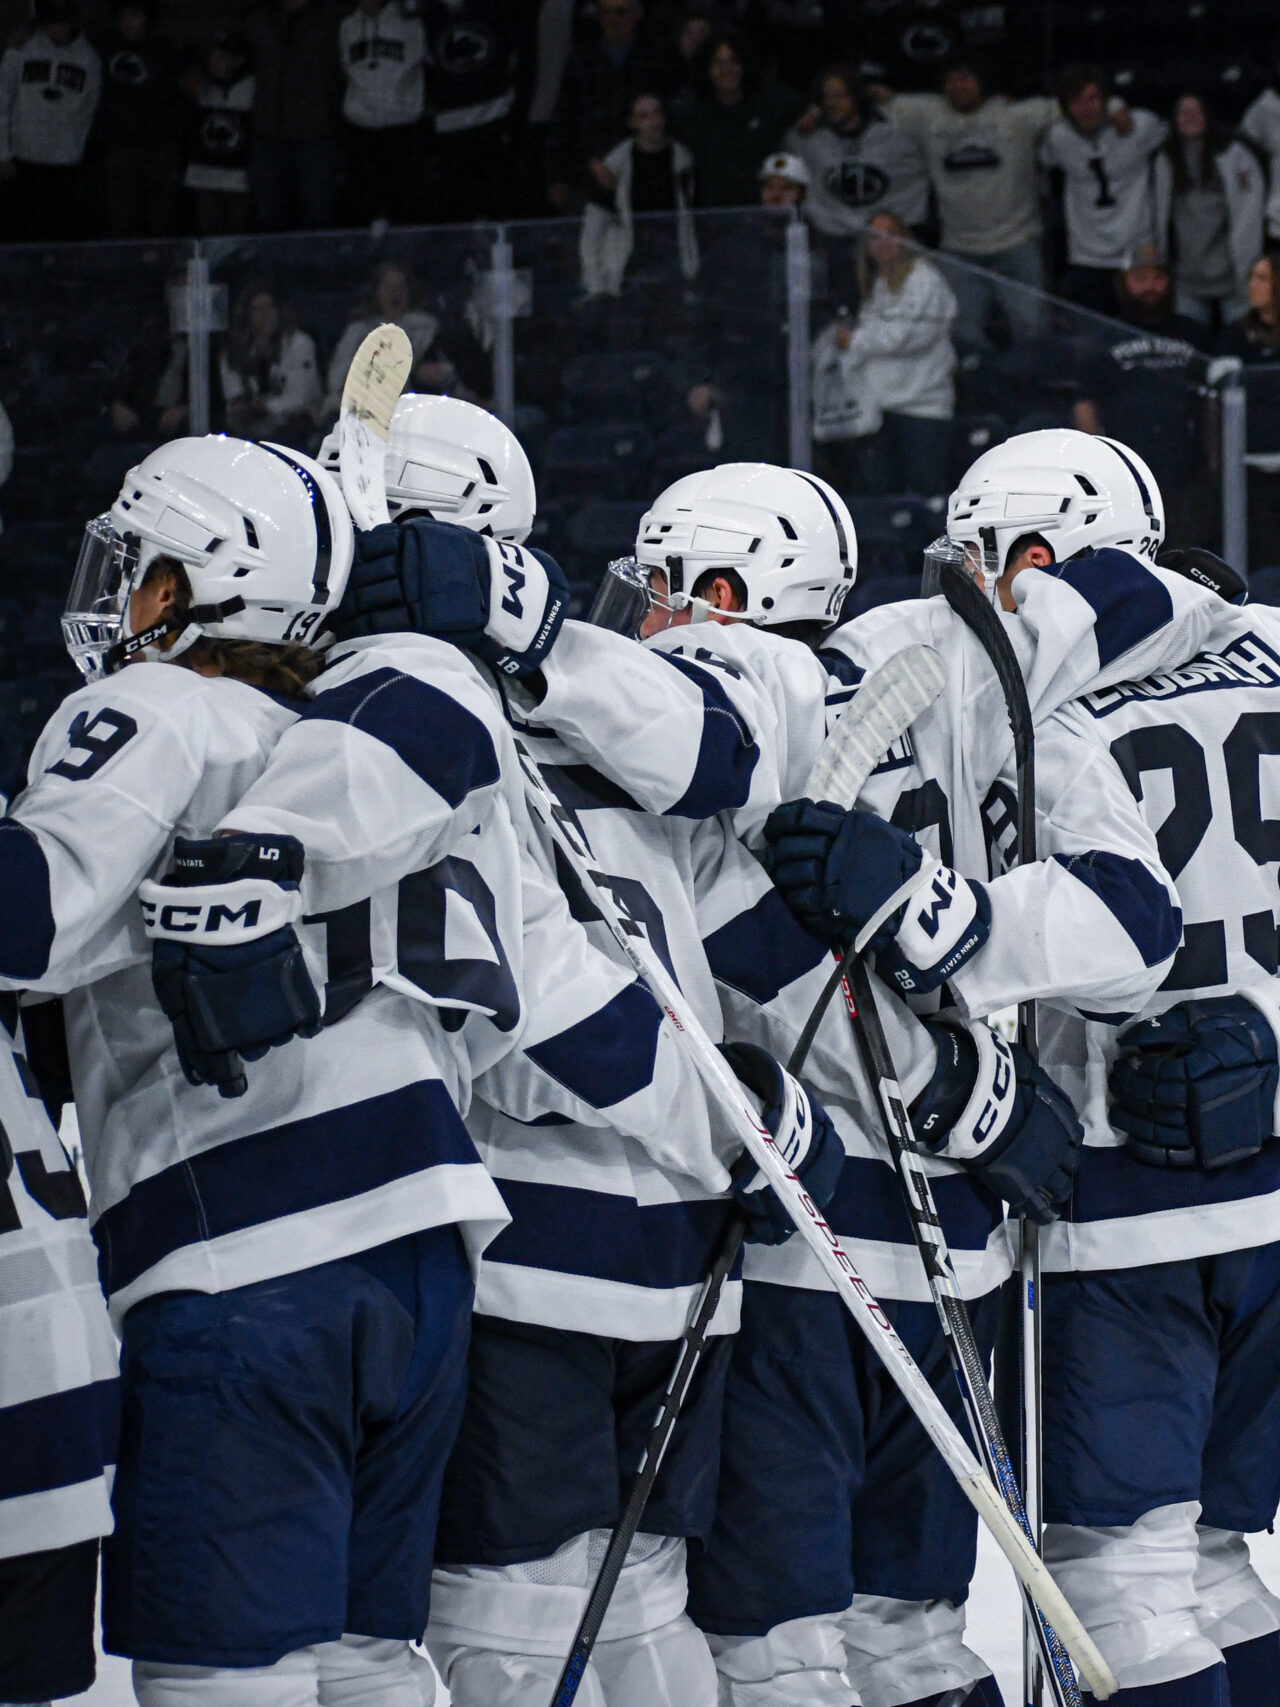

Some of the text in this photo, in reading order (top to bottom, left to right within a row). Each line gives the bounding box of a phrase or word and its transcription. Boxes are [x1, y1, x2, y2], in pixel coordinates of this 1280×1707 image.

[1088, 158, 1117, 207] 1
[1189, 567, 1221, 592] CCM
[824, 583, 850, 617] 18
[126, 624, 168, 652] CCM
[282, 609, 322, 642] 19
[534, 599, 563, 650] PENN STATE
[496, 655, 520, 675] 18
[258, 846, 280, 861] 5
[939, 934, 979, 975] PENN STATE
[894, 969, 916, 990] 29
[922, 1113, 940, 1130] 5
[745, 1108, 893, 1332] JETSPEED
